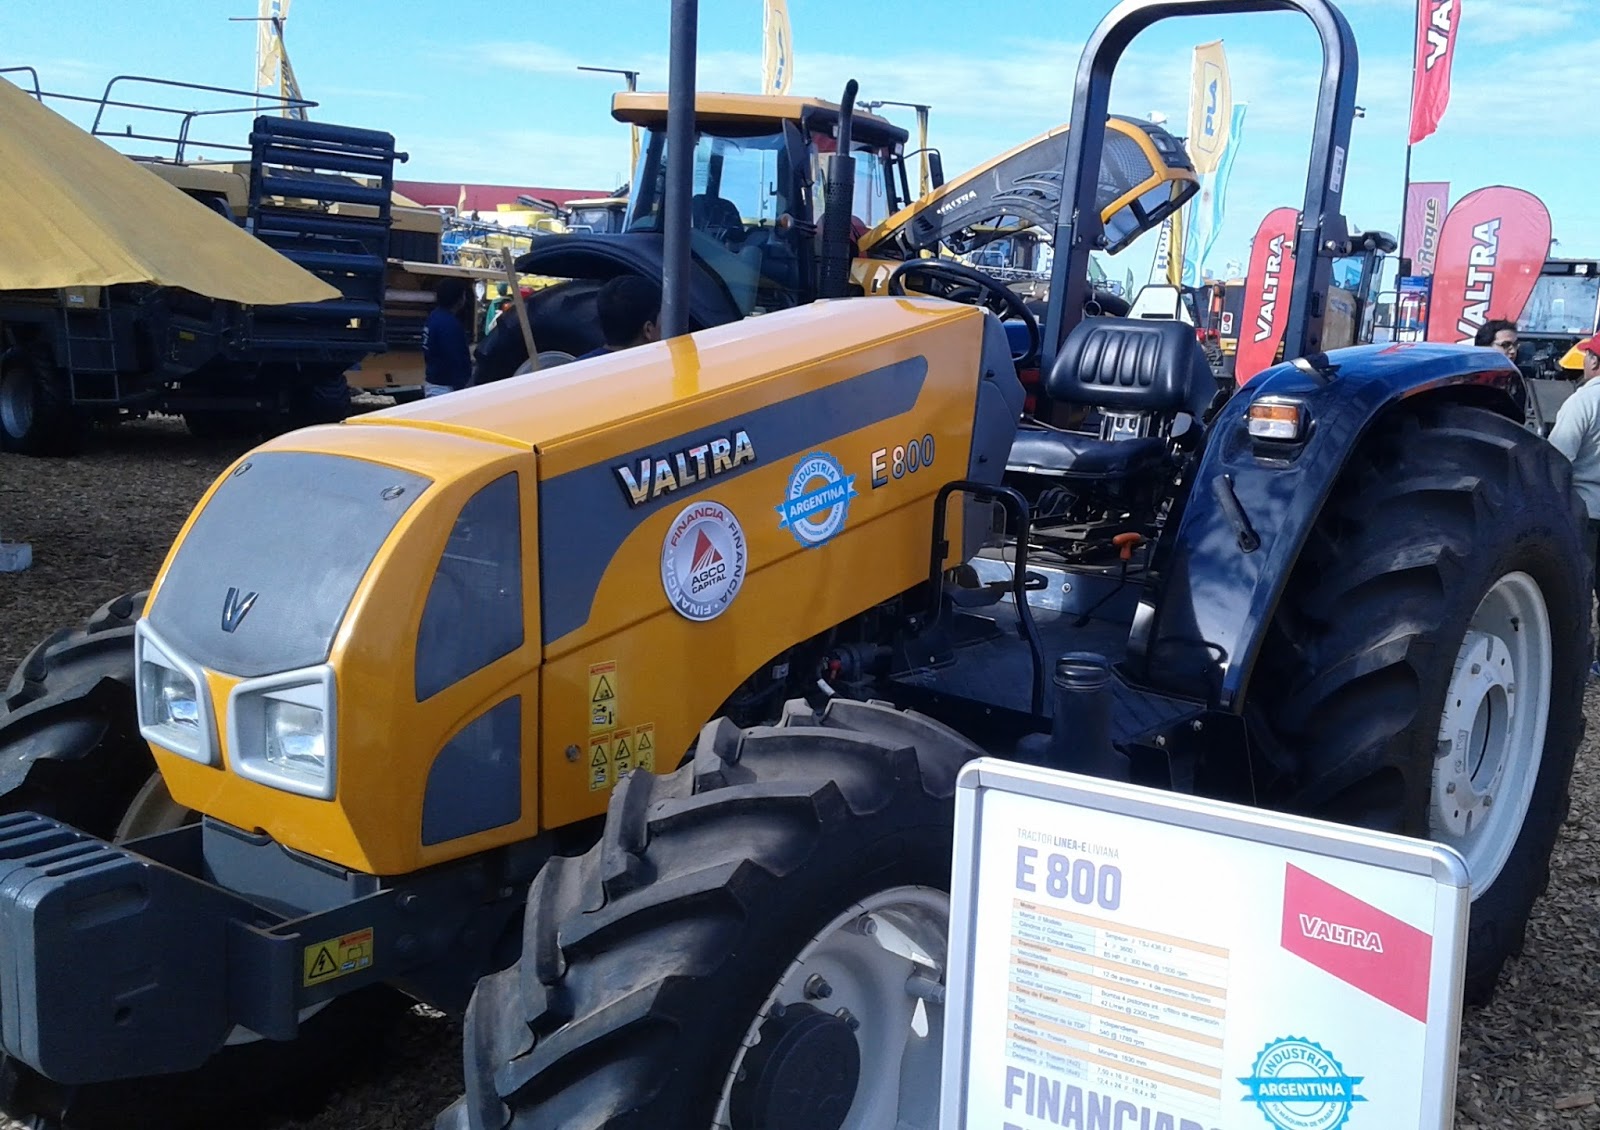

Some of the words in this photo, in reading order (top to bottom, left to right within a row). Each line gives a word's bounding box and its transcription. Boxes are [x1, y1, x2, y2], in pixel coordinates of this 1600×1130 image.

[1204, 78, 1217, 136] PLA
[1417, 198, 1438, 264] Roque
[1254, 233, 1285, 343] VALTRA
[616, 429, 757, 506] VALTRA
[871, 447, 888, 490] E
[892, 433, 935, 480] 800
[793, 461, 836, 496] INDUSTRIA
[789, 485, 846, 518] ARGENTINA
[671, 507, 724, 547] FINANCIA
[691, 563, 726, 587] AGCO
[719, 521, 743, 603] FINANCIA
[667, 557, 712, 616] FINANCIA
[692, 574, 727, 594] CAPITAL
[1017, 828, 1052, 845] TRACTOR
[1088, 843, 1119, 859] LIVIANA
[1016, 845, 1038, 892] E
[1046, 853, 1122, 911] 800
[1299, 913, 1384, 953] VALTRA
[1103, 971, 1110, 979] 12
[1153, 964, 1160, 972] @
[1039, 993, 1058, 1003] Fuerza
[1125, 1006, 1132, 1015] @
[1148, 1012, 1160, 1020] rpm
[1127, 997, 1150, 1009] pistones
[1111, 1032, 1117, 1041] @
[1133, 1038, 1145, 1046] rpm
[1263, 1047, 1329, 1076] INDUSTRIA
[1258, 1082, 1346, 1097] ARGENTINA
